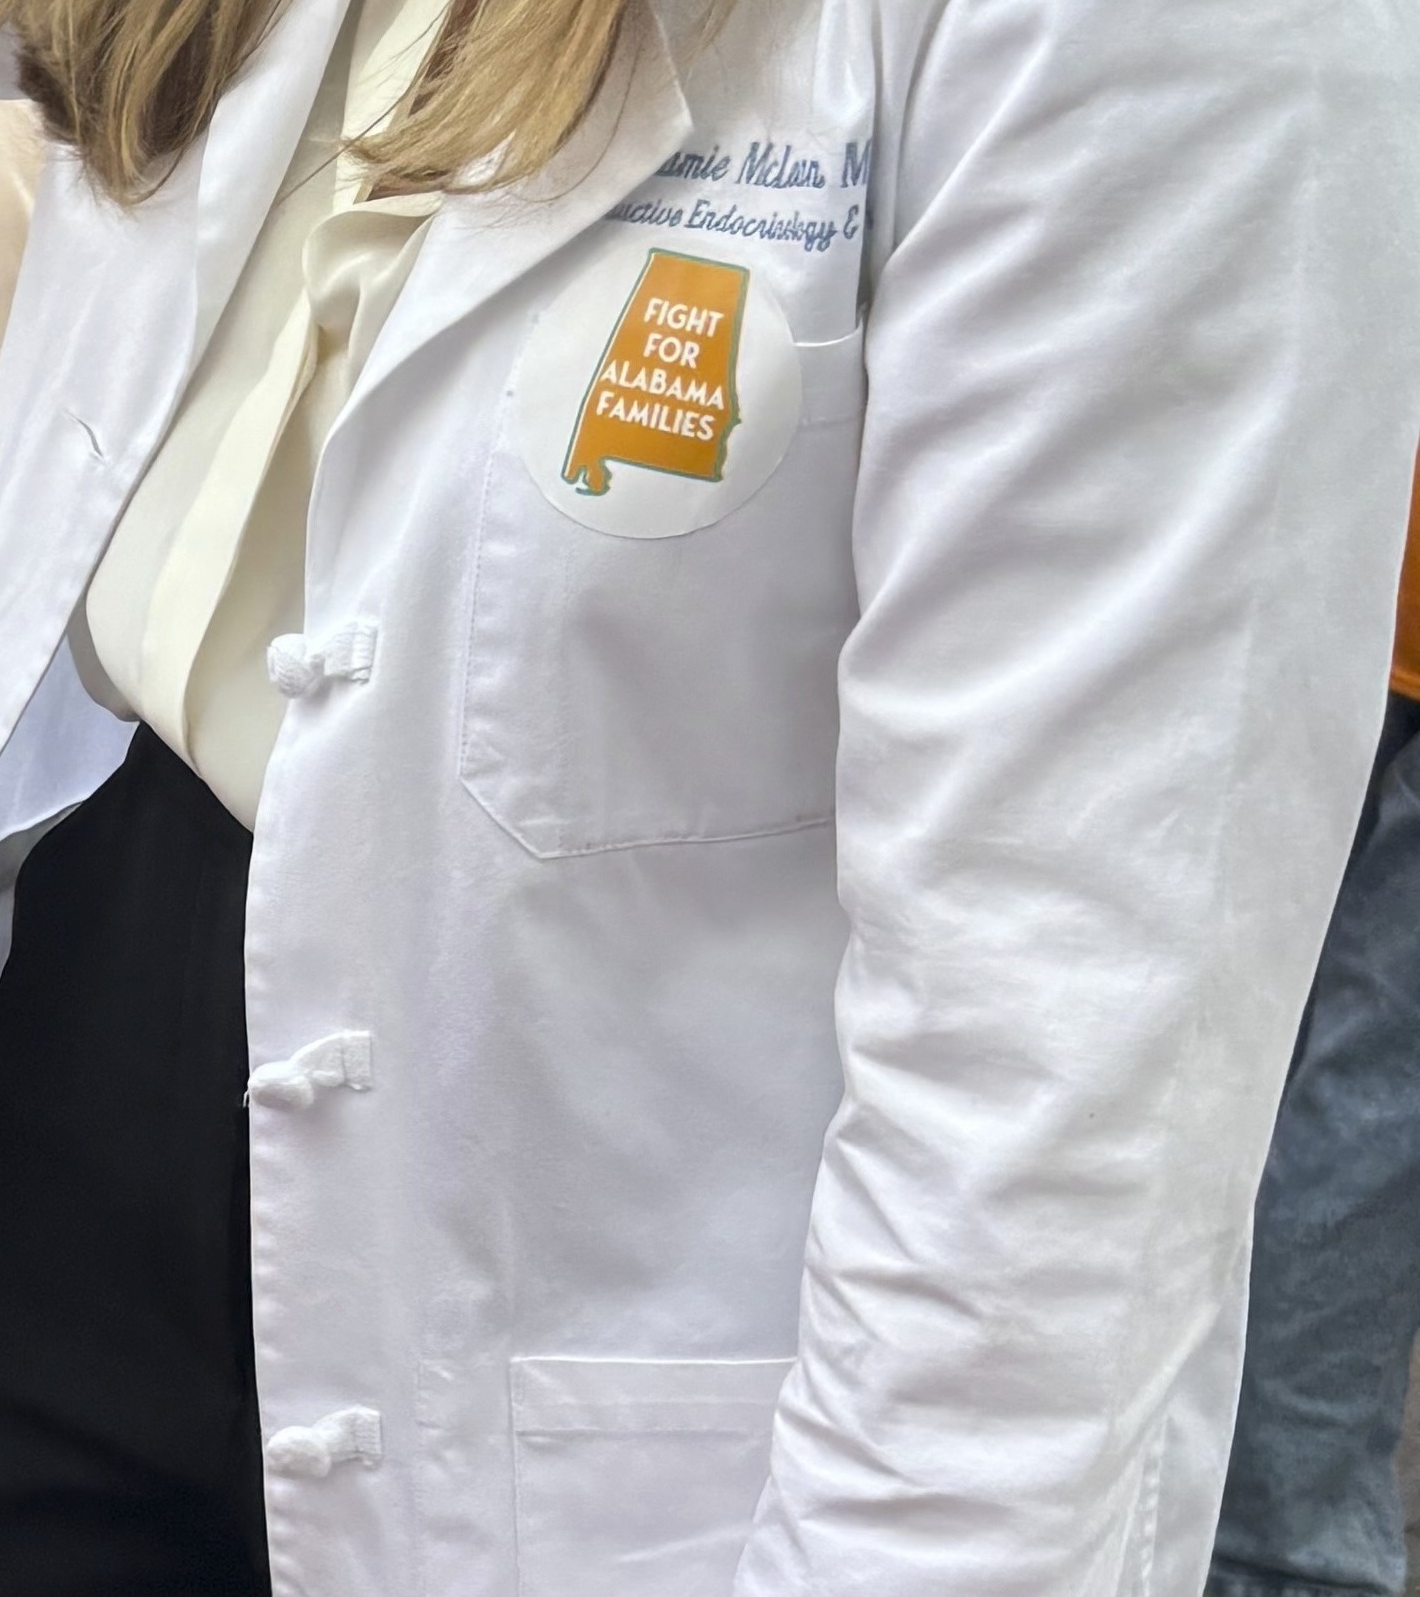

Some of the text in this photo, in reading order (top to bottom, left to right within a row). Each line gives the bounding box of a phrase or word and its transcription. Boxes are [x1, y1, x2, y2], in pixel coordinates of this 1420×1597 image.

[644, 297, 725, 338] FIGHT
[643, 332, 700, 369] FOR
[599, 359, 725, 410] ALABAMA
[596, 390, 716, 441] FAMILIES
